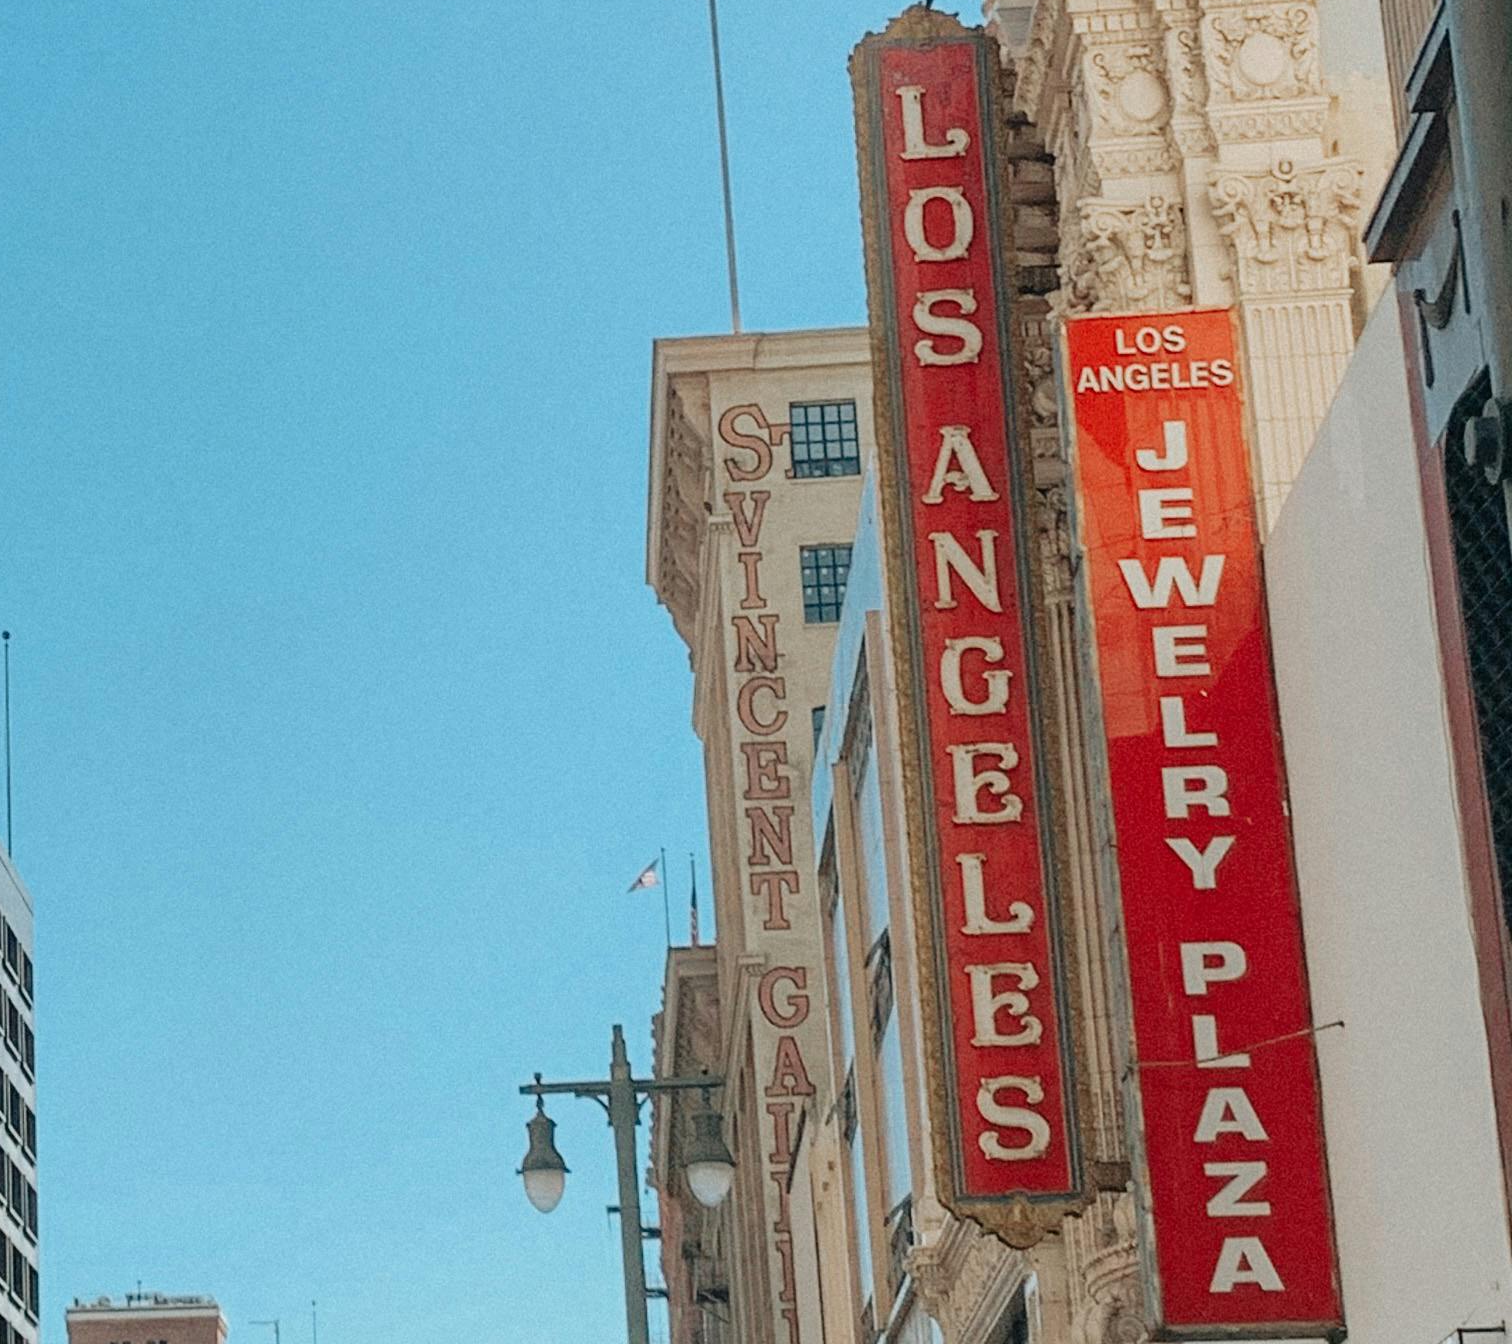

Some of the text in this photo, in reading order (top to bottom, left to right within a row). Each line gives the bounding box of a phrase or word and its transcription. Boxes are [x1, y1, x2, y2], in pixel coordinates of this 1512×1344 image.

[1076, 358, 1234, 395] ANGELES
[1115, 326, 1187, 355] LOS
[723, 490, 800, 930] VINCENT
[895, 85, 1051, 1162] LOS ANGELES
[1118, 420, 1285, 1293] JEWELRY PLAZA
